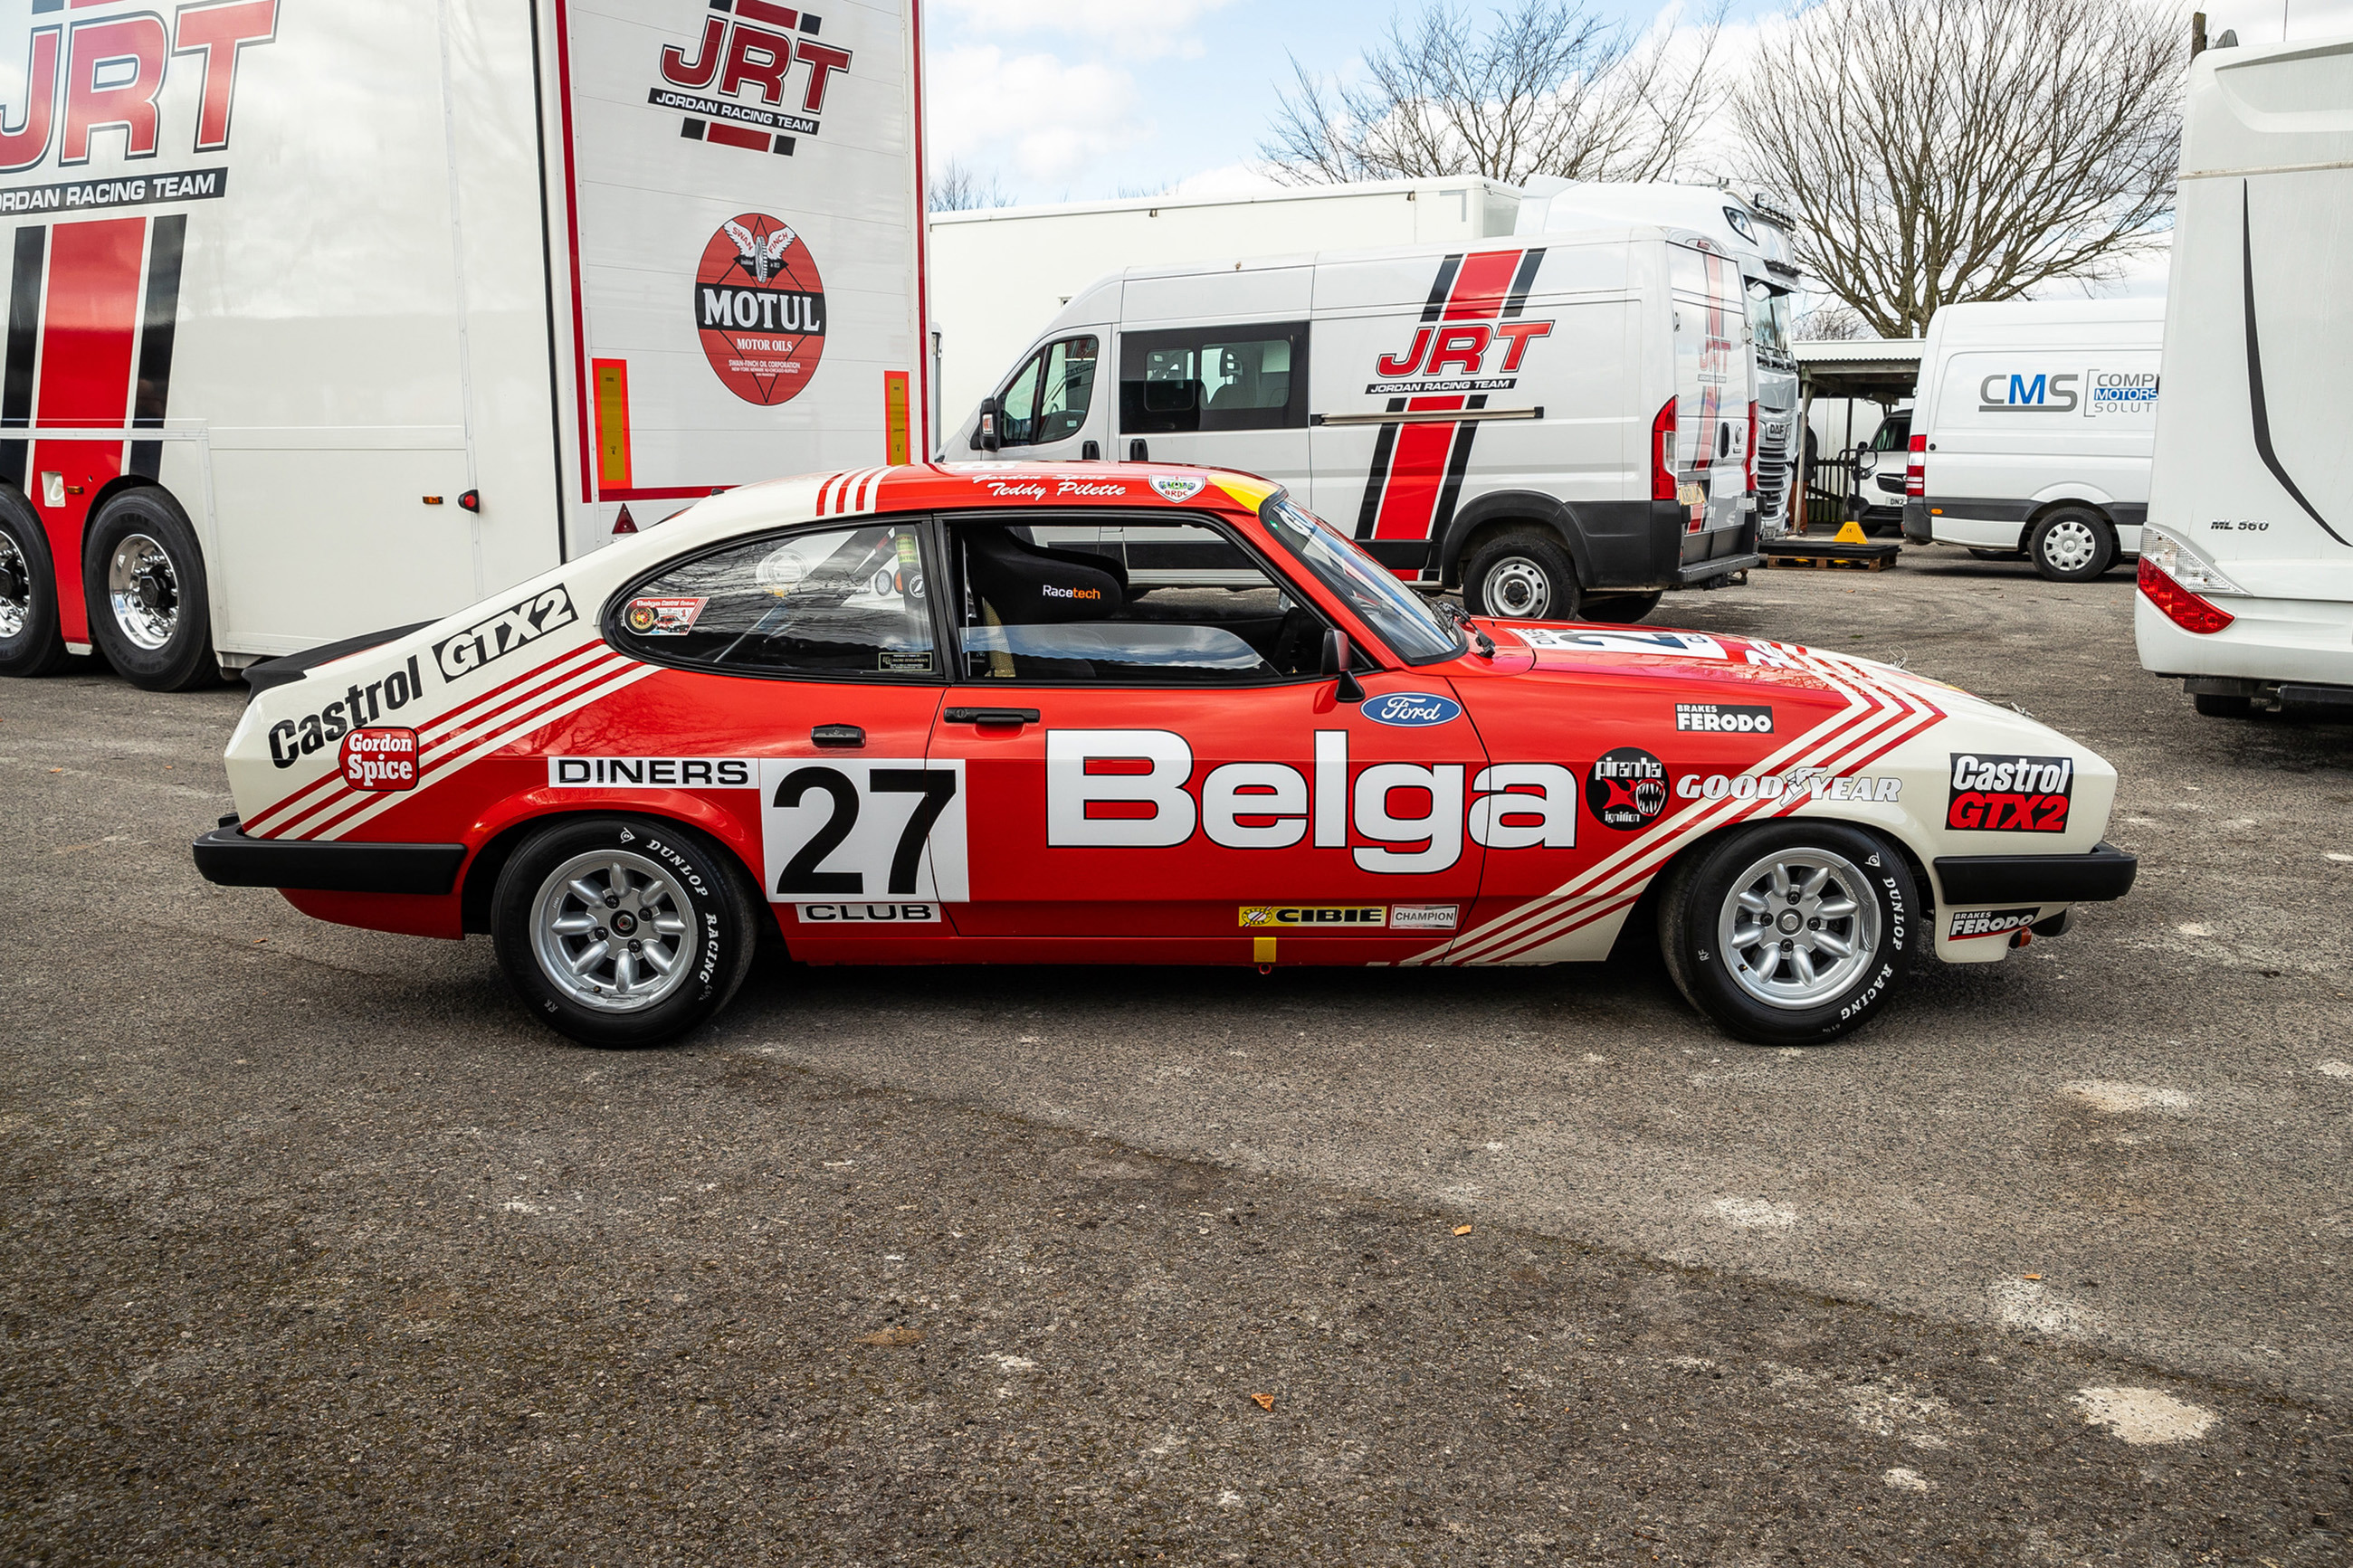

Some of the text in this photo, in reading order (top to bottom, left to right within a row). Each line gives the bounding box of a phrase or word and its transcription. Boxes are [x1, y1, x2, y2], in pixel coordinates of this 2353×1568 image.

[660, 14, 853, 115] JRT
[0, 0, 280, 174] JRT
[656, 92, 814, 132] JORDAN RACING TEAM
[0, 173, 215, 212] RDAN RACING TEAM
[732, 226, 789, 254] SWAN FINCH
[703, 289, 820, 331] MOTUL
[736, 338, 793, 352] MOTOR OILS
[1376, 319, 1556, 378] JRT
[1370, 380, 1510, 394] JORDAN RACING TEAM
[2097, 374, 2161, 387] COMP
[1979, 374, 2079, 412] CMS
[2094, 402, 2158, 413] SOLUT
[1770, 424, 1785, 434] DAF
[987, 481, 1127, 500] Teddy Pilette
[1165, 489, 1188, 498] BRDC
[2210, 519, 2269, 531] ML 560
[1043, 584, 1100, 600] Racetech
[268, 587, 573, 769] Castrol GTX2
[1381, 697, 1441, 722] Ford
[1676, 704, 1718, 713] BRAKES
[1677, 713, 1773, 732] FERODO
[348, 733, 413, 754] Gordon
[348, 755, 413, 787] Spice
[558, 759, 749, 785] DINERS
[1595, 756, 1662, 780] piranha
[1952, 755, 2071, 794] Castrol
[1045, 729, 1577, 874] Belga
[1948, 792, 2068, 831] GTX2
[773, 766, 957, 895] 27
[646, 839, 719, 984] DUNLOP RACING
[805, 905, 931, 921] CLUB
[1395, 910, 1454, 921] CHAMPION
[1955, 911, 1992, 920] BRAKES
[1951, 914, 2034, 936] FERODO
[1698, 949, 1710, 962] RF
[1840, 877, 1905, 1020] DUNLOP RACING
[544, 999, 558, 1012] RR
